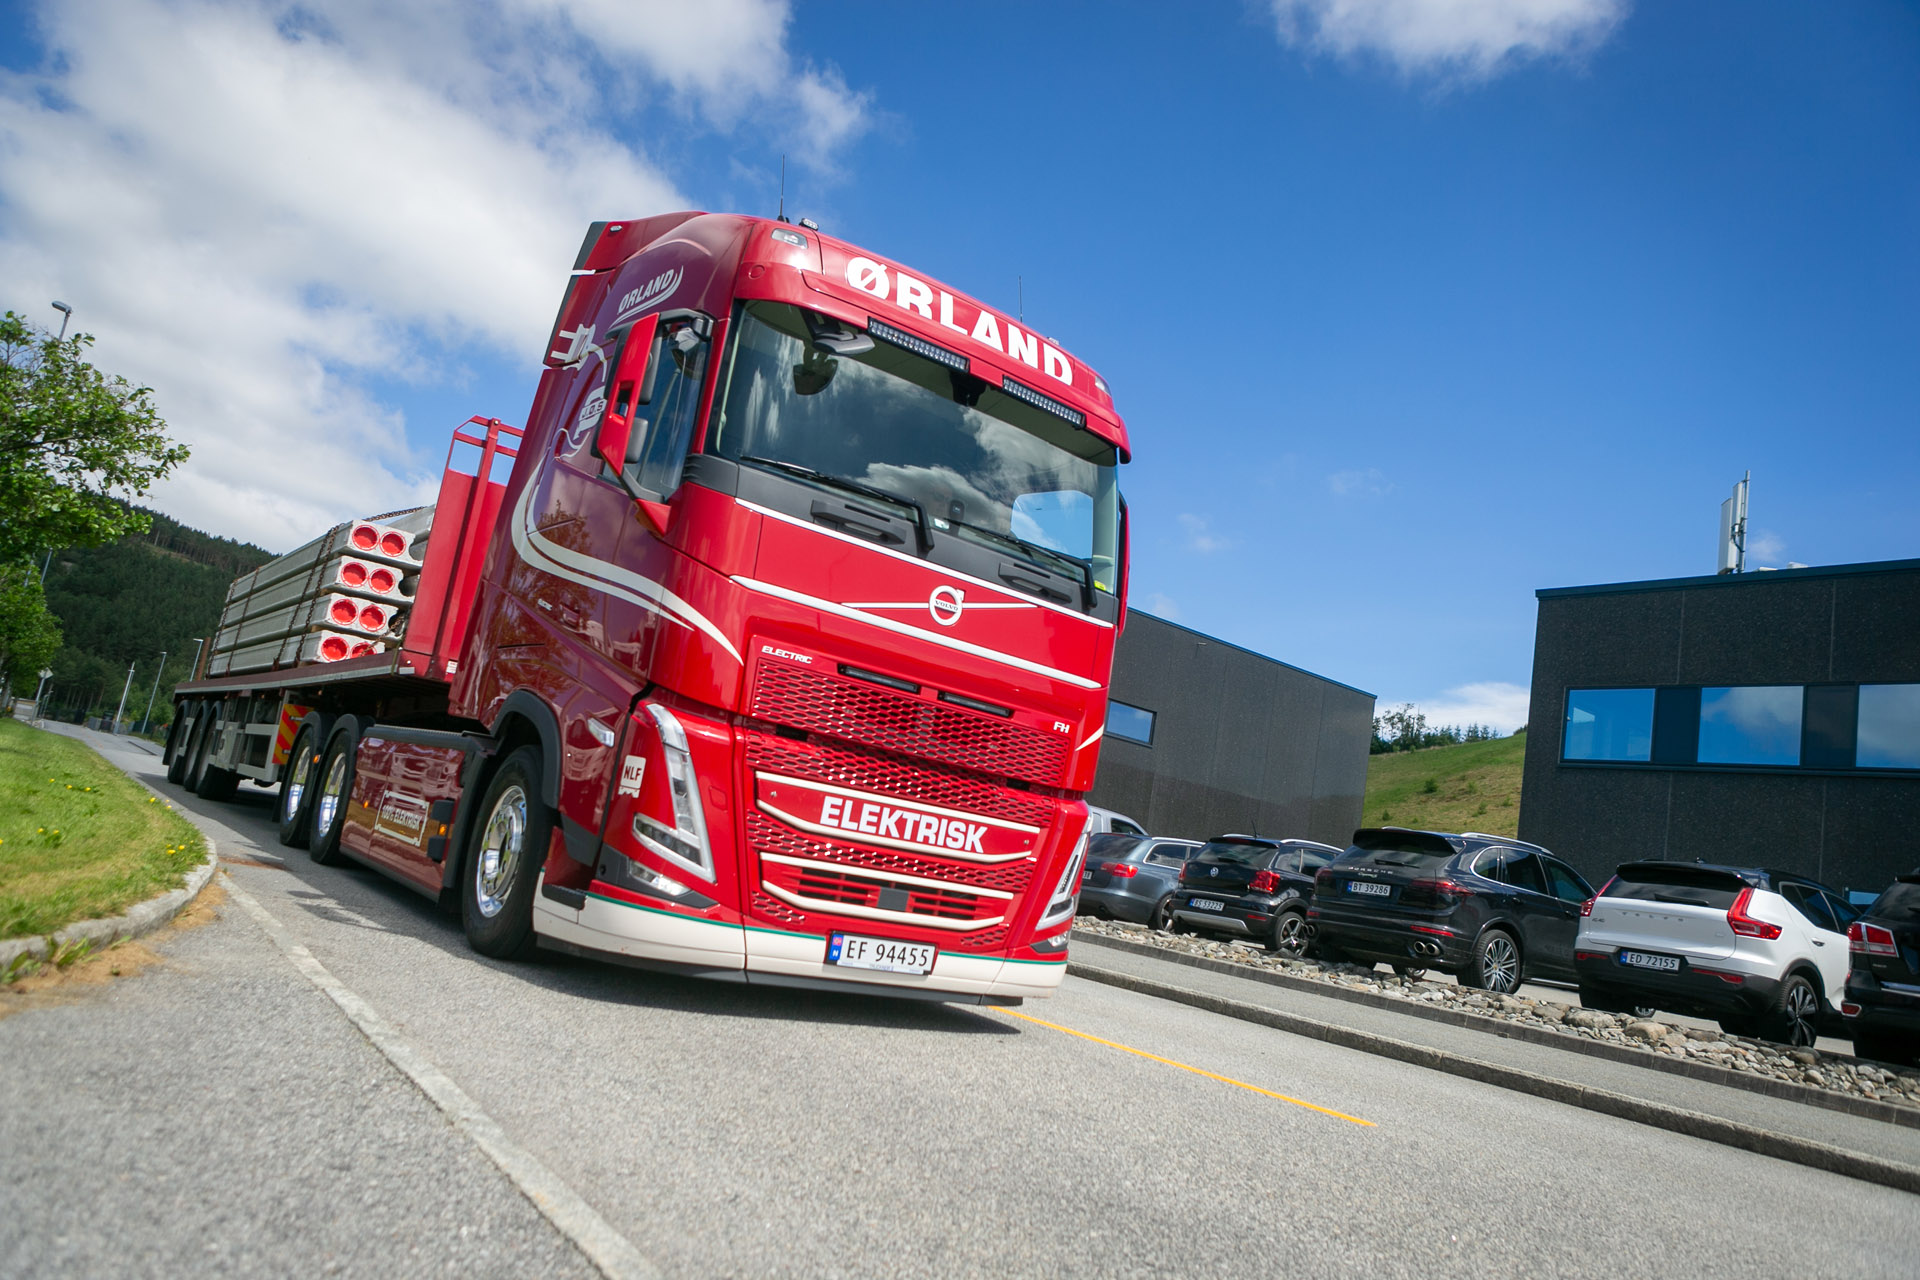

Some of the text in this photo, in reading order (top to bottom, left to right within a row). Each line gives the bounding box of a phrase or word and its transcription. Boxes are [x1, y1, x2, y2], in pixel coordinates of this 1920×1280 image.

[617, 269, 675, 315] ØRLAND
[846, 256, 1073, 386] ØRLAND
[935, 600, 959, 612] VOLVO
[761, 645, 813, 664] ELECTRIC
[1053, 721, 1070, 734] FH
[624, 765, 642, 781] NLF
[393, 808, 422, 831] ELEKTRISK
[819, 795, 988, 854] ELEKTRISK
[1353, 882, 1388, 895] BT 39286
[846, 940, 868, 960] EF
[875, 943, 929, 967] 94455
[1629, 953, 1676, 969] ED 72155
